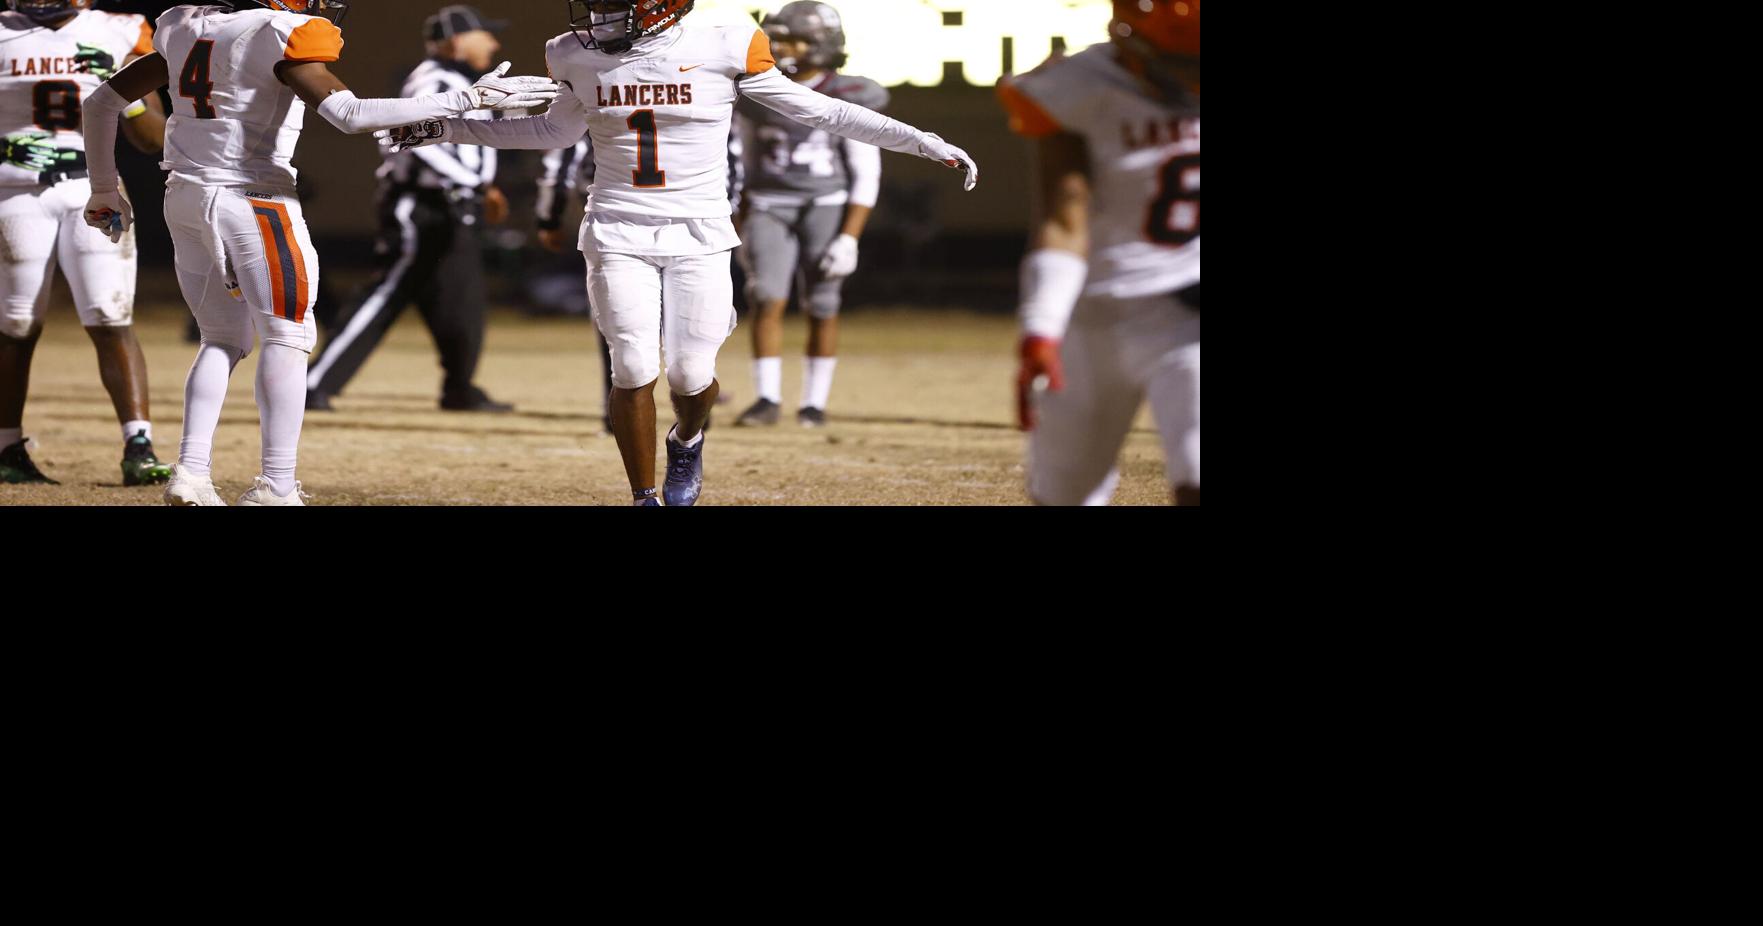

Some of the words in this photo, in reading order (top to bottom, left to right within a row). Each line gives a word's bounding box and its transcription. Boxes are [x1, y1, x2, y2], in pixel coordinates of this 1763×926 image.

[32, 79, 80, 131] 8
[179, 39, 216, 119] 4
[596, 84, 692, 106] LANCERS
[626, 109, 666, 187] 1
[758, 127, 834, 176] 34
